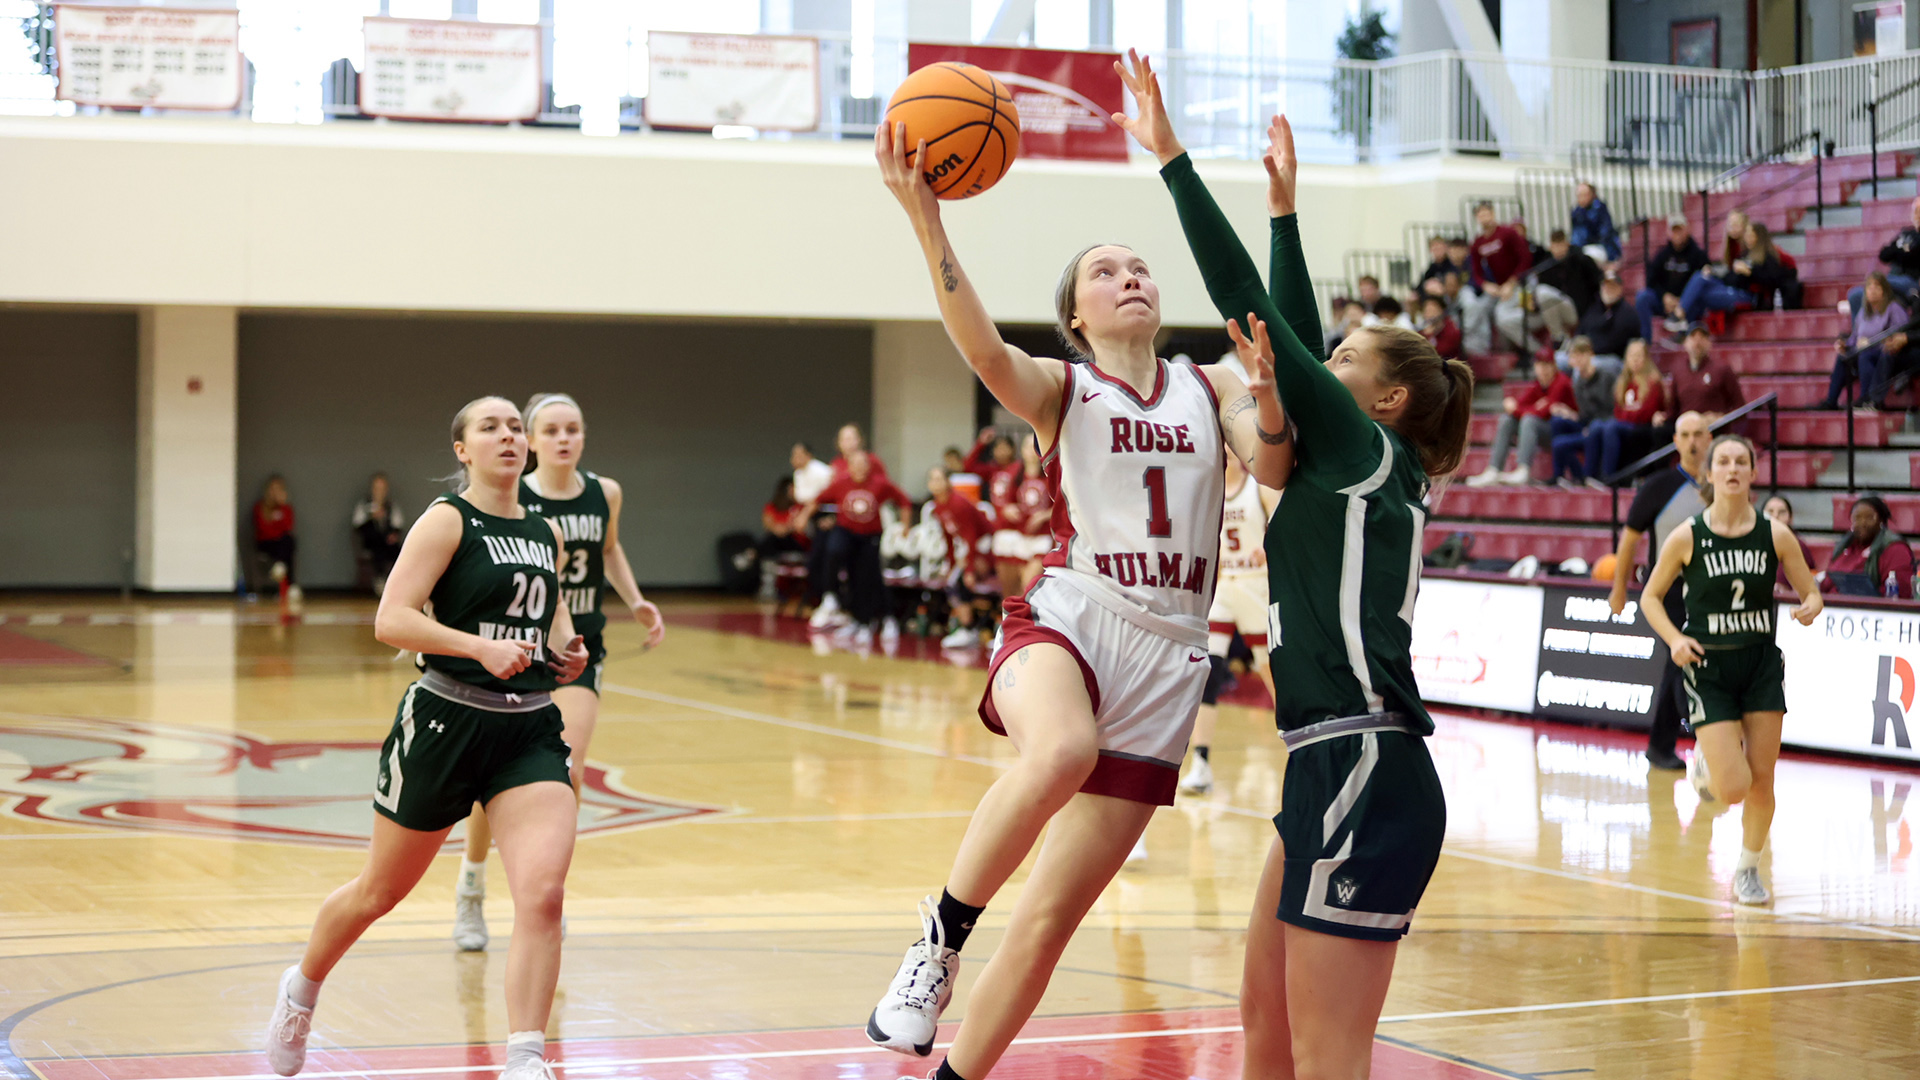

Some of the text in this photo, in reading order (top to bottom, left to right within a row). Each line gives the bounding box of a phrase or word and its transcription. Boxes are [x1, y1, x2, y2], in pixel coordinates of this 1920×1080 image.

[1110, 417, 1195, 453] ROSE
[1142, 466, 1172, 538] 1
[482, 535, 556, 573] ILLINOIS
[1226, 528, 1241, 551] 5
[1703, 549, 1767, 578] ILLINOIS
[505, 571, 547, 620] 20
[1730, 578, 1746, 611] 2
[1707, 609, 1771, 635] WESLEYAN
[1826, 615, 1920, 644] ROSE-H
